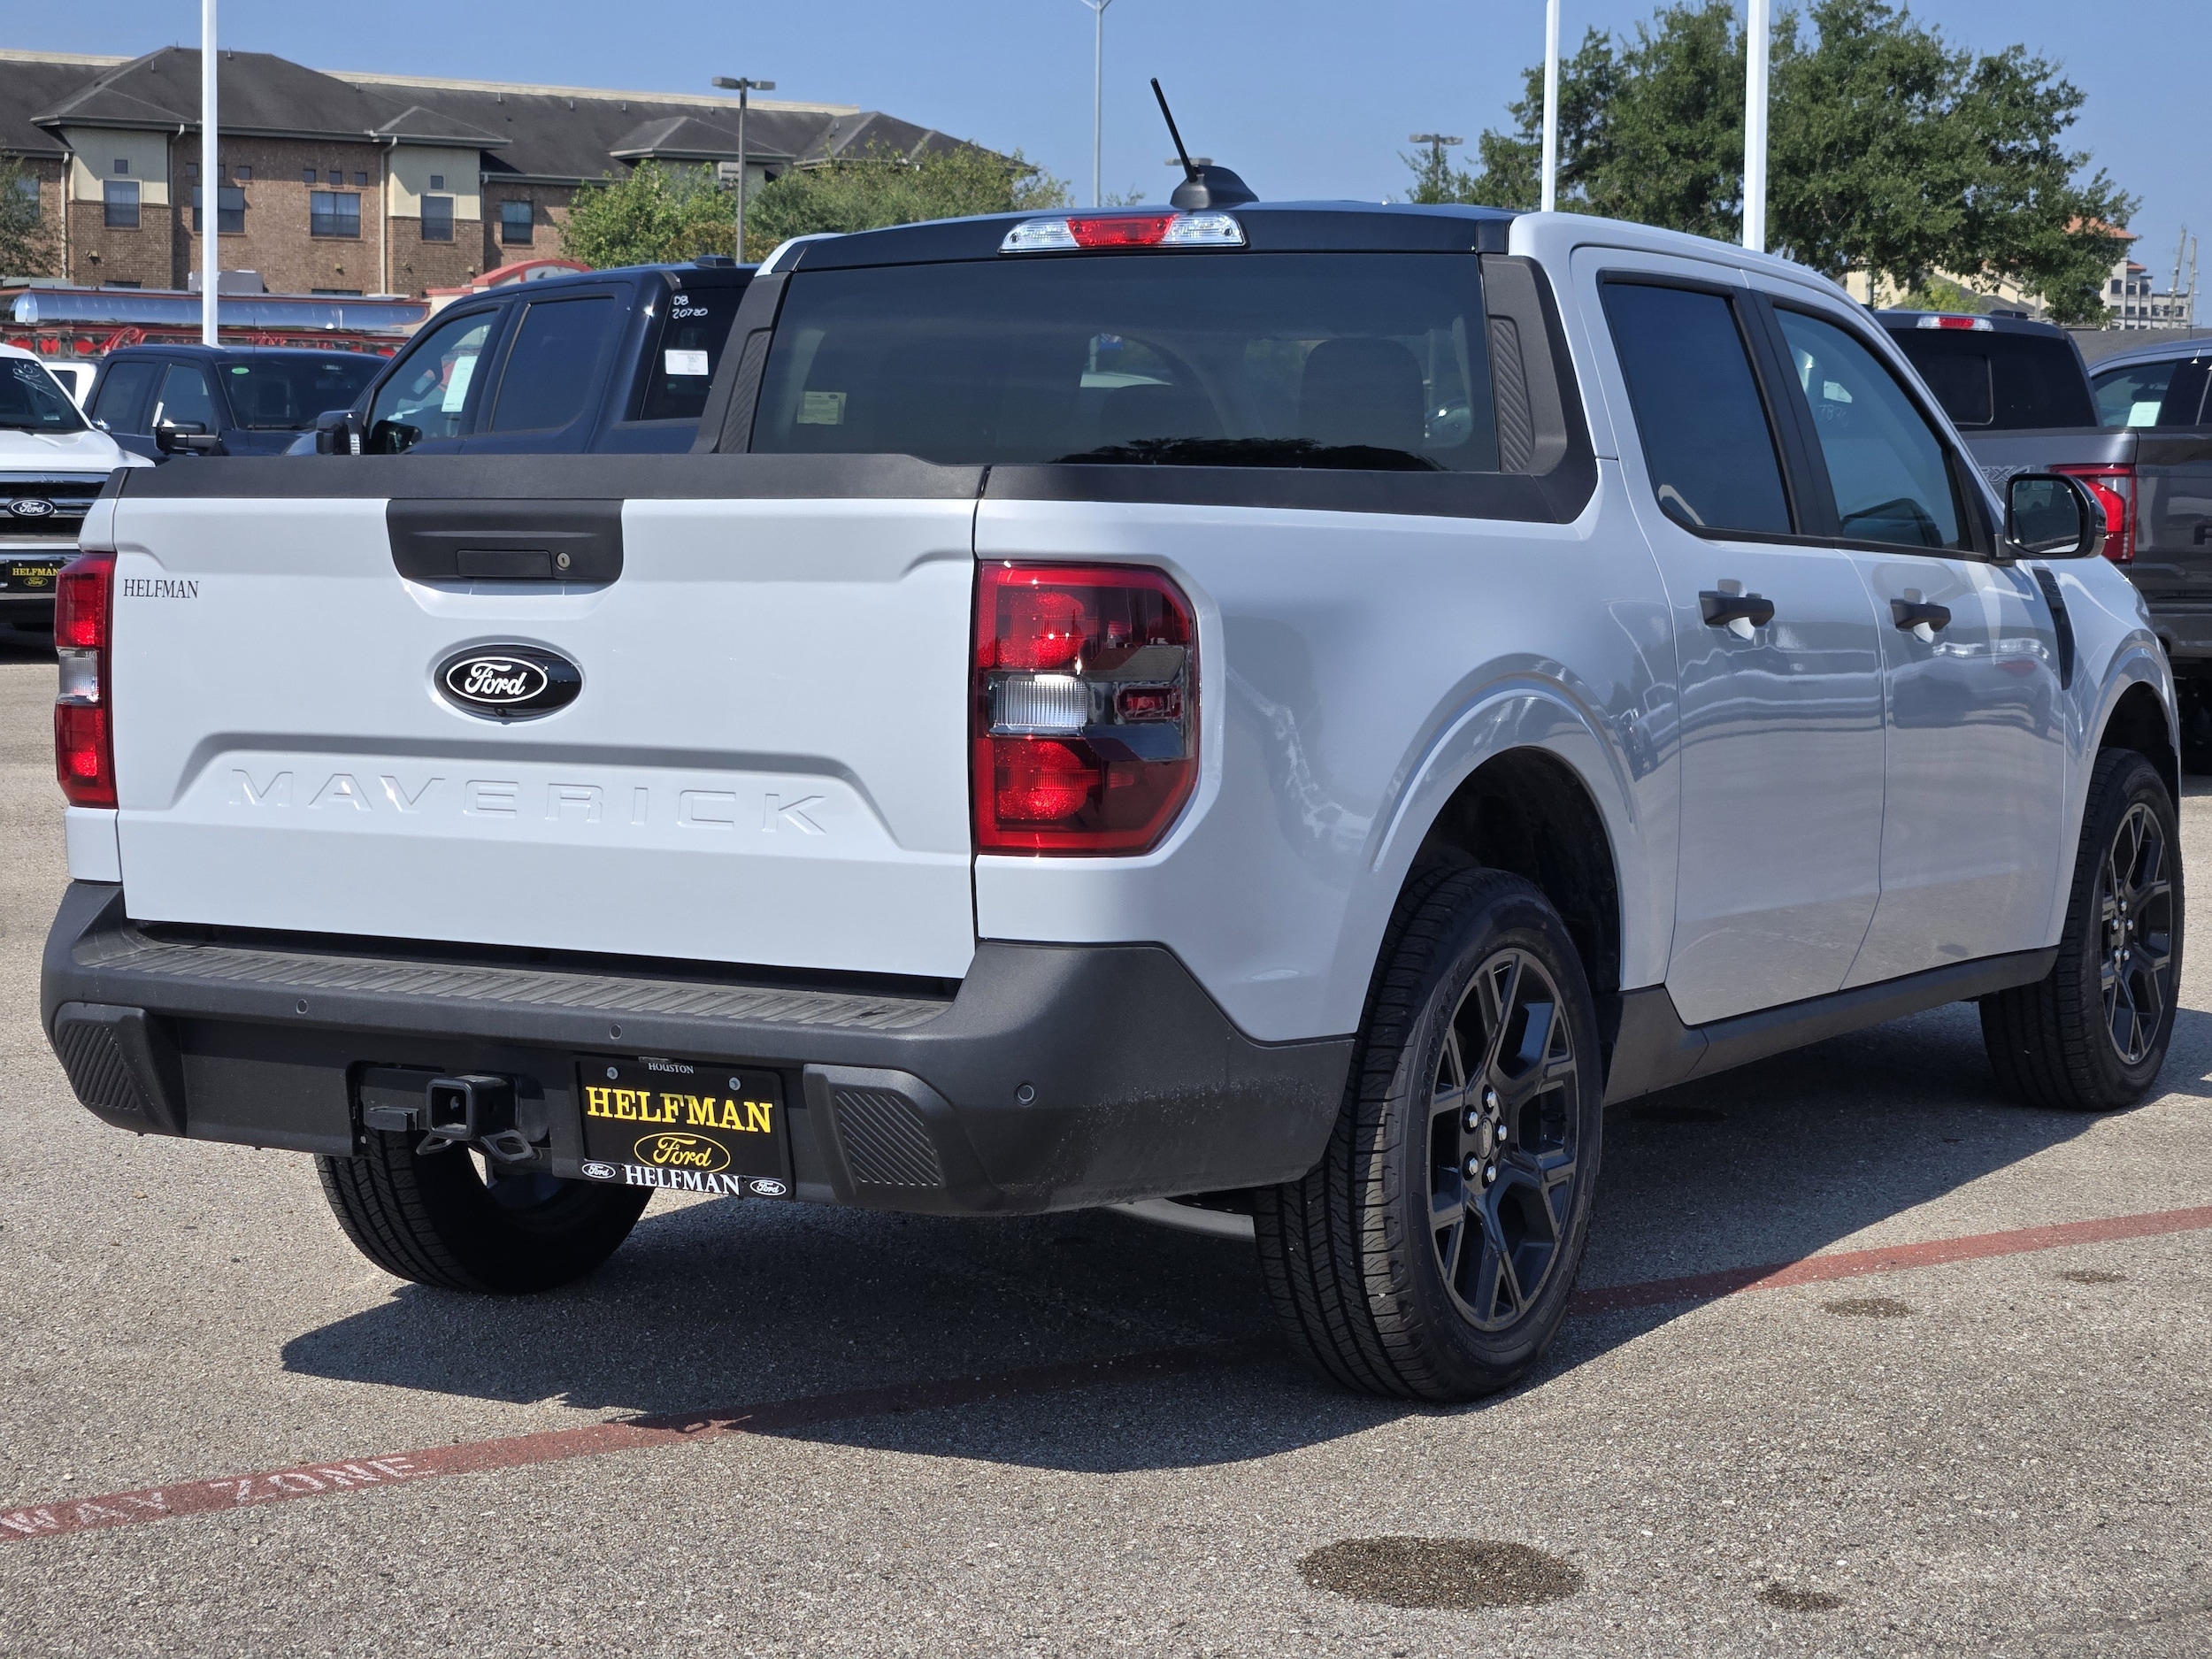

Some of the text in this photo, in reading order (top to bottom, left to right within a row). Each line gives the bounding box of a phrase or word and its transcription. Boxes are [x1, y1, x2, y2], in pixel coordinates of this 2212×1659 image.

[12, 567, 59, 577] HELFMAN
[123, 578, 199, 599] HELFMAN
[464, 663, 528, 695] Ford
[228, 768, 827, 836] MAVERICK
[648, 1062, 695, 1074] HOUSTON
[585, 1086, 773, 1133] HELFMAN
[653, 1136, 712, 1167] Ford
[588, 1164, 780, 1196] Ford HELFMAN Ford
